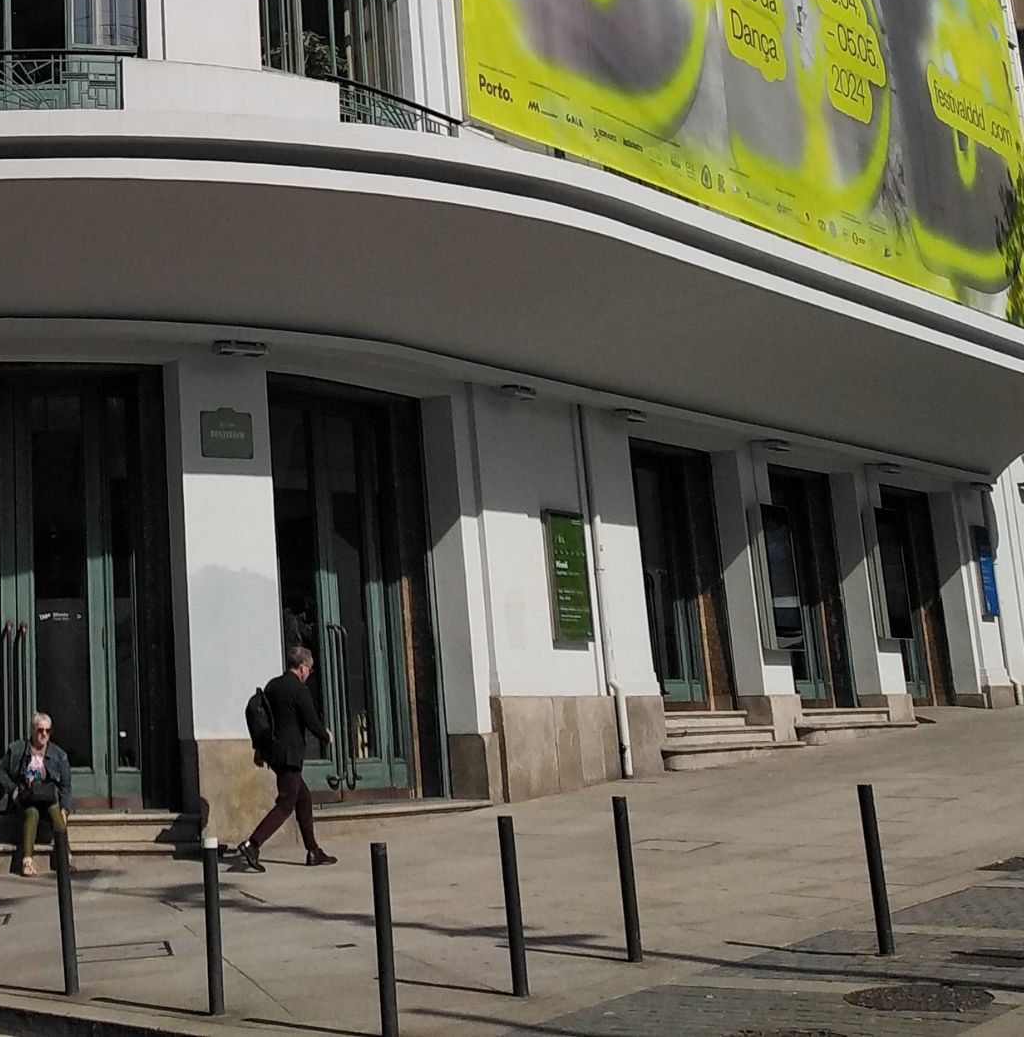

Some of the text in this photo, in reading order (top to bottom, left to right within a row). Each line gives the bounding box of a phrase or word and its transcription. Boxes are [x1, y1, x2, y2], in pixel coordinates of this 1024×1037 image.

[730, 8, 779, 62] Dança
[478, 73, 514, 104] Porto.
[832, 64, 866, 106] 2024
